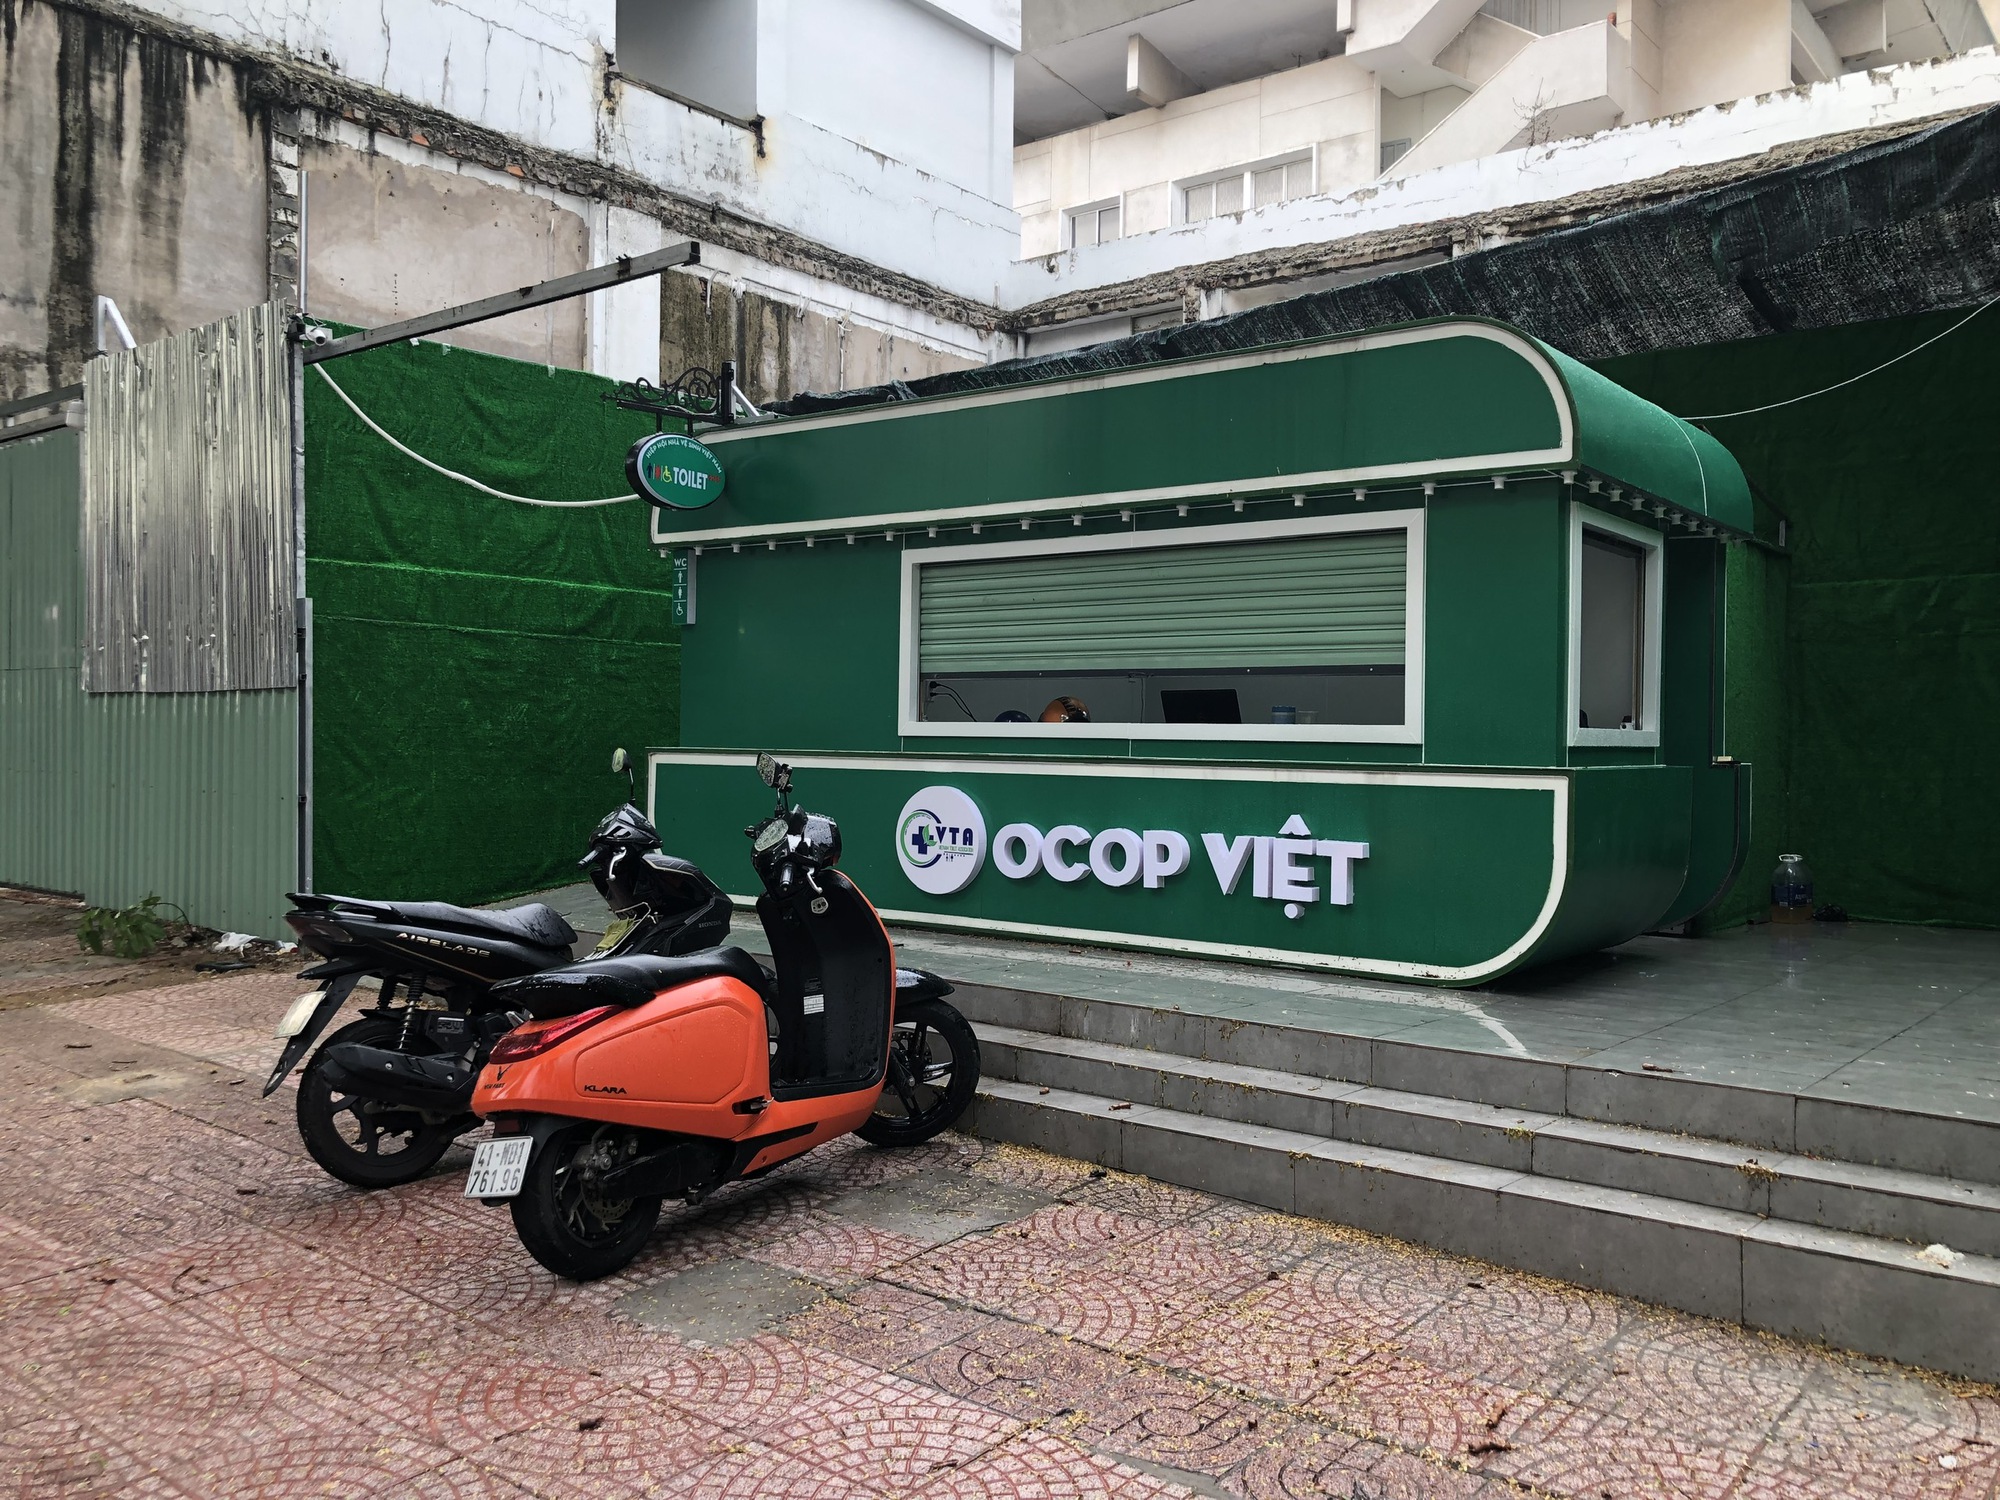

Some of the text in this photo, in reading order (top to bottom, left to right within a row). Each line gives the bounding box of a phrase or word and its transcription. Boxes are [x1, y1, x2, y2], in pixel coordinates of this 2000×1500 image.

[673, 467, 708, 490] TOILET
[674, 558, 687, 567] WC
[935, 826, 973, 846] VTA
[992, 814, 1369, 919] OCOP VIỆT
[698, 920, 722, 929] HONDA
[584, 1085, 627, 1095] KLARA
[469, 1168, 521, 1194] 761.96
